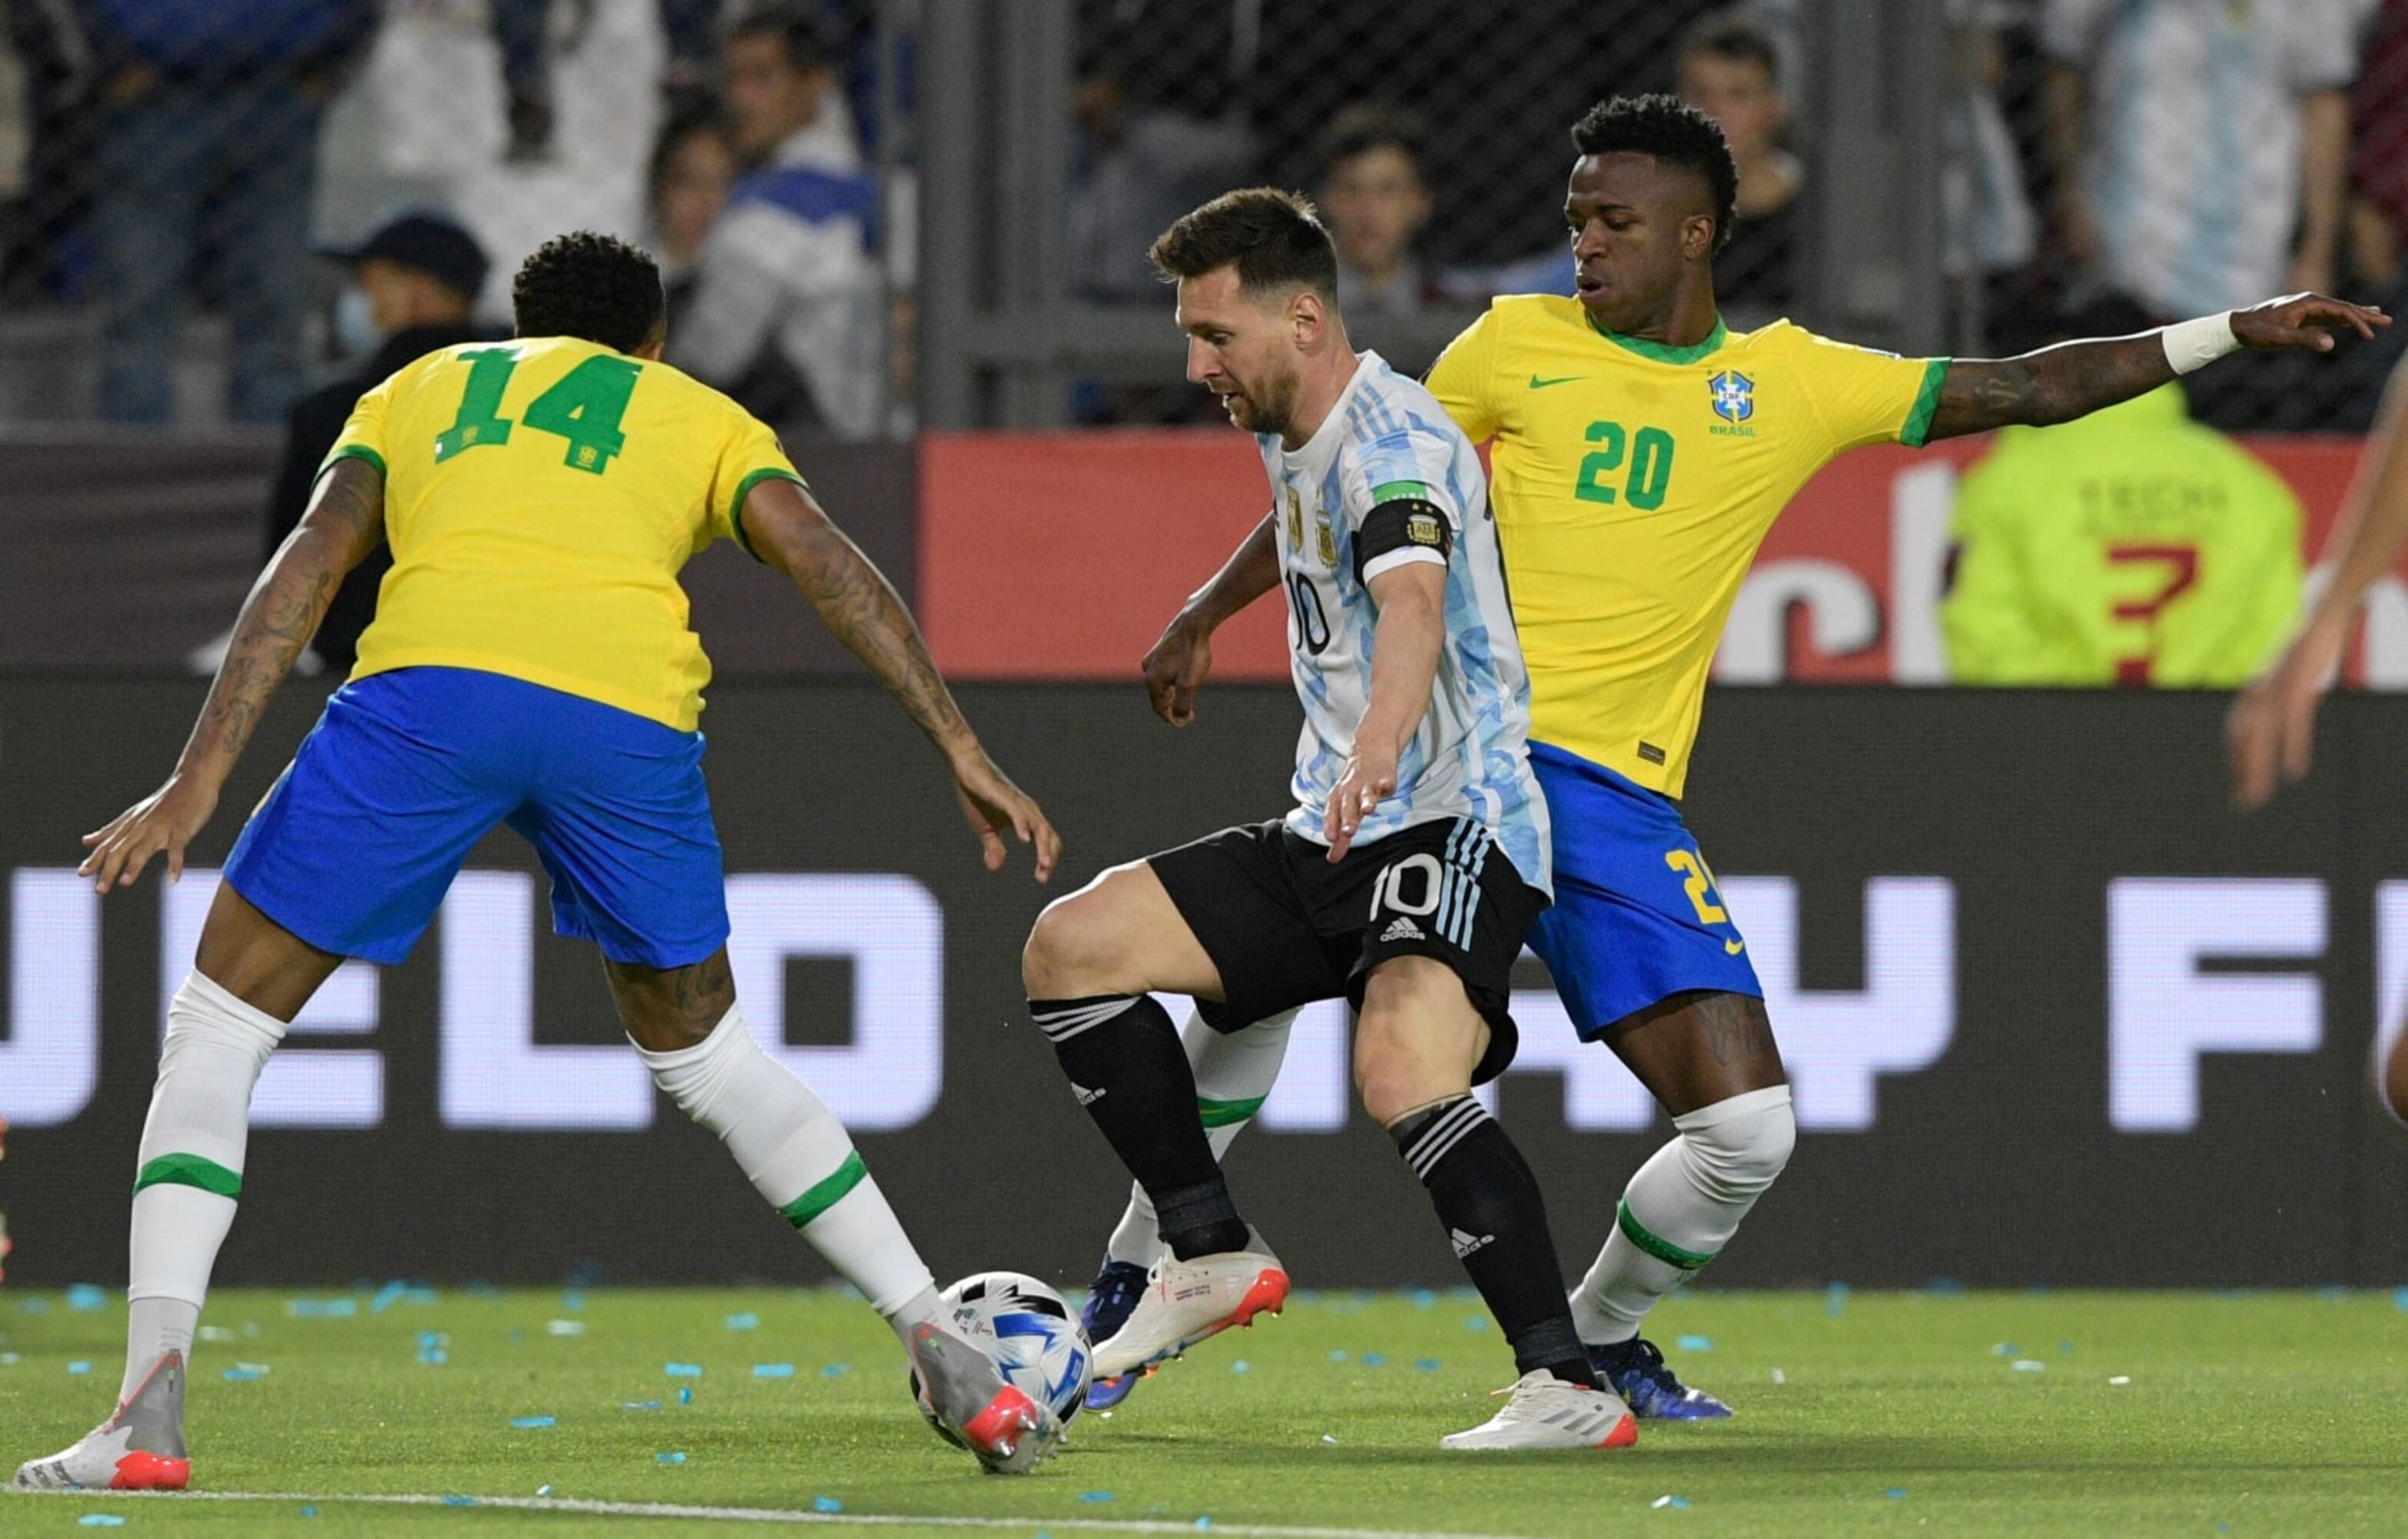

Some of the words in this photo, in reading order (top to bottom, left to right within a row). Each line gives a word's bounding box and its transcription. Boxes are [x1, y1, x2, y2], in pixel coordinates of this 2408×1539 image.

[435, 348, 643, 476] 14
[1709, 425, 1756, 438] BRASIL
[1574, 420, 1675, 512] 20
[1286, 568, 1331, 656] 10
[1369, 853, 1442, 922] 10
[1666, 850, 1729, 924] 2
[1379, 929, 1426, 942] adidas
